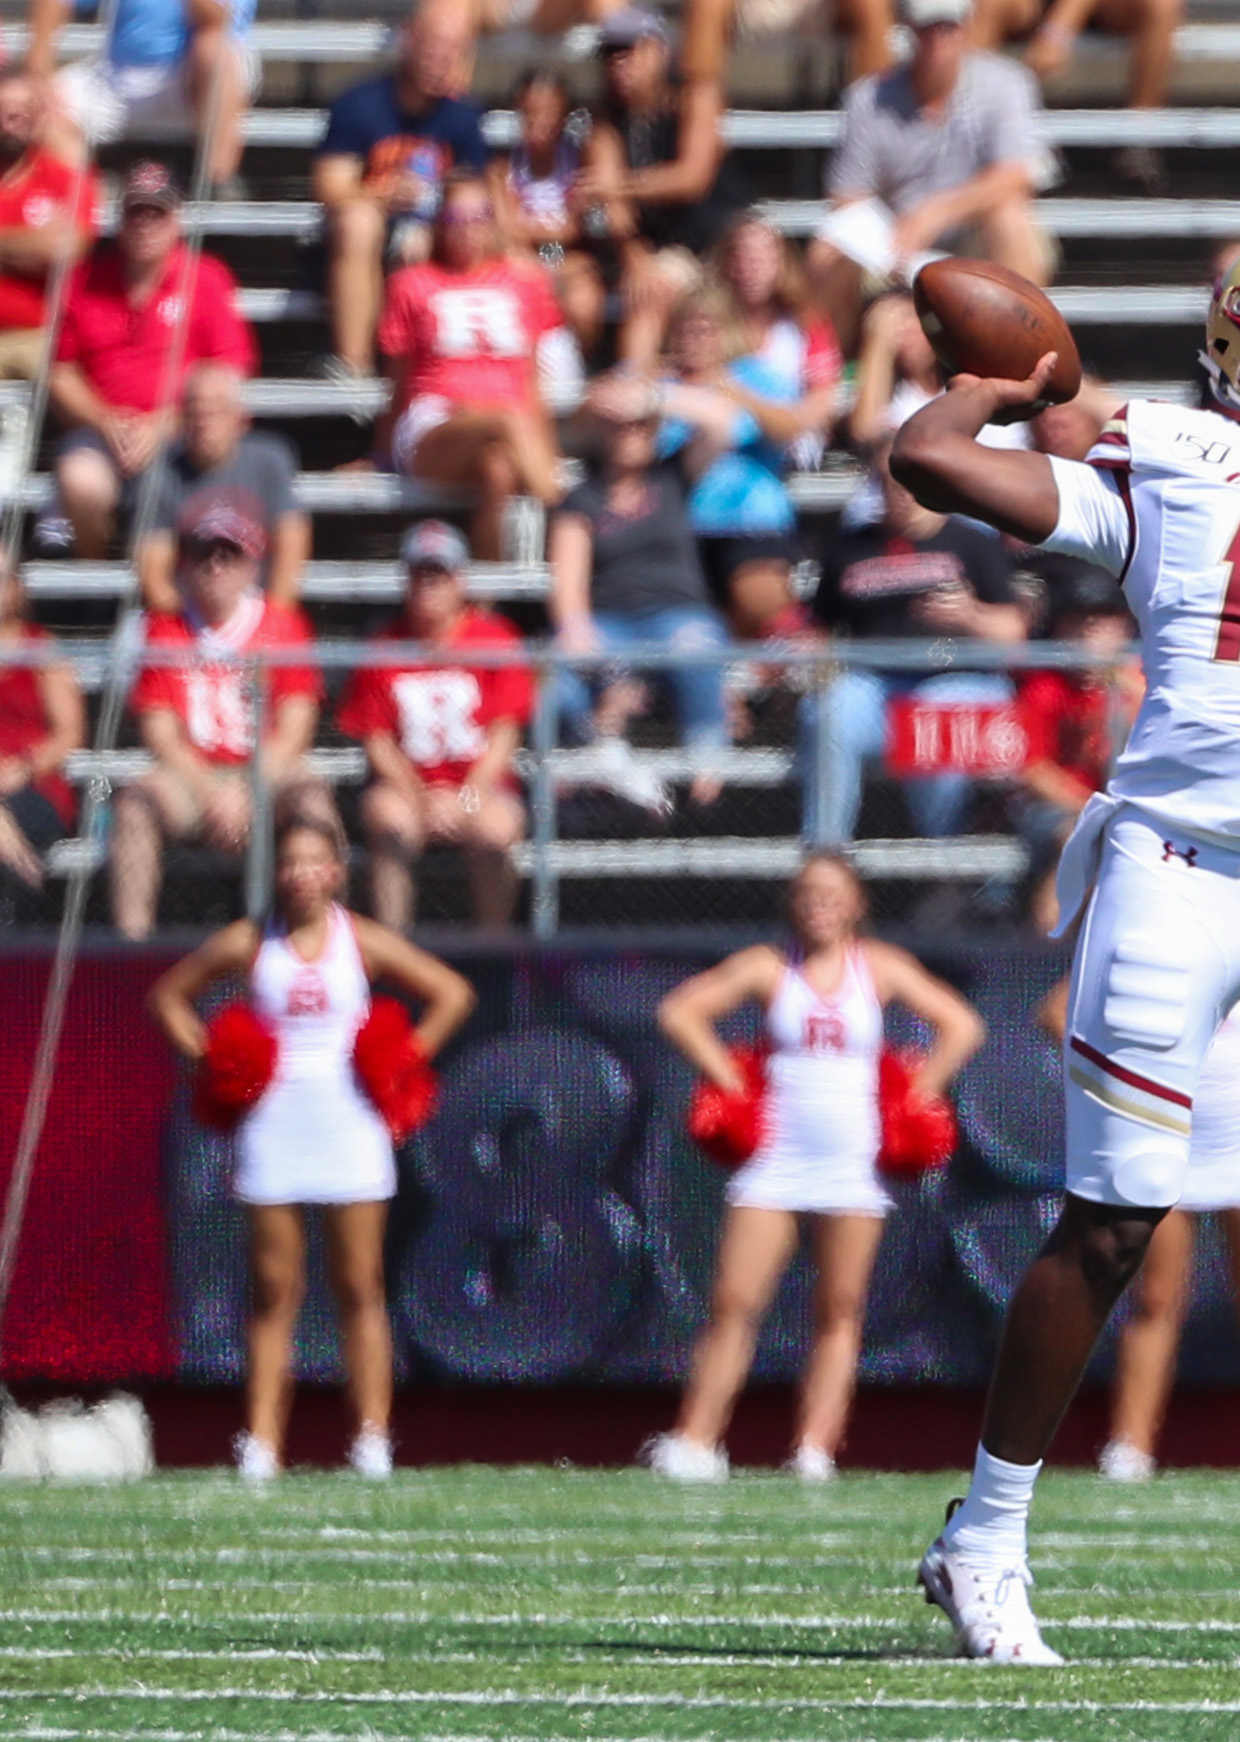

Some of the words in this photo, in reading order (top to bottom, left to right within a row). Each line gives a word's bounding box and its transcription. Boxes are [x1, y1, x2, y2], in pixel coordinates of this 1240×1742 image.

[429, 288, 527, 357] R
[393, 669, 488, 768] R
[803, 1015, 847, 1051] R
